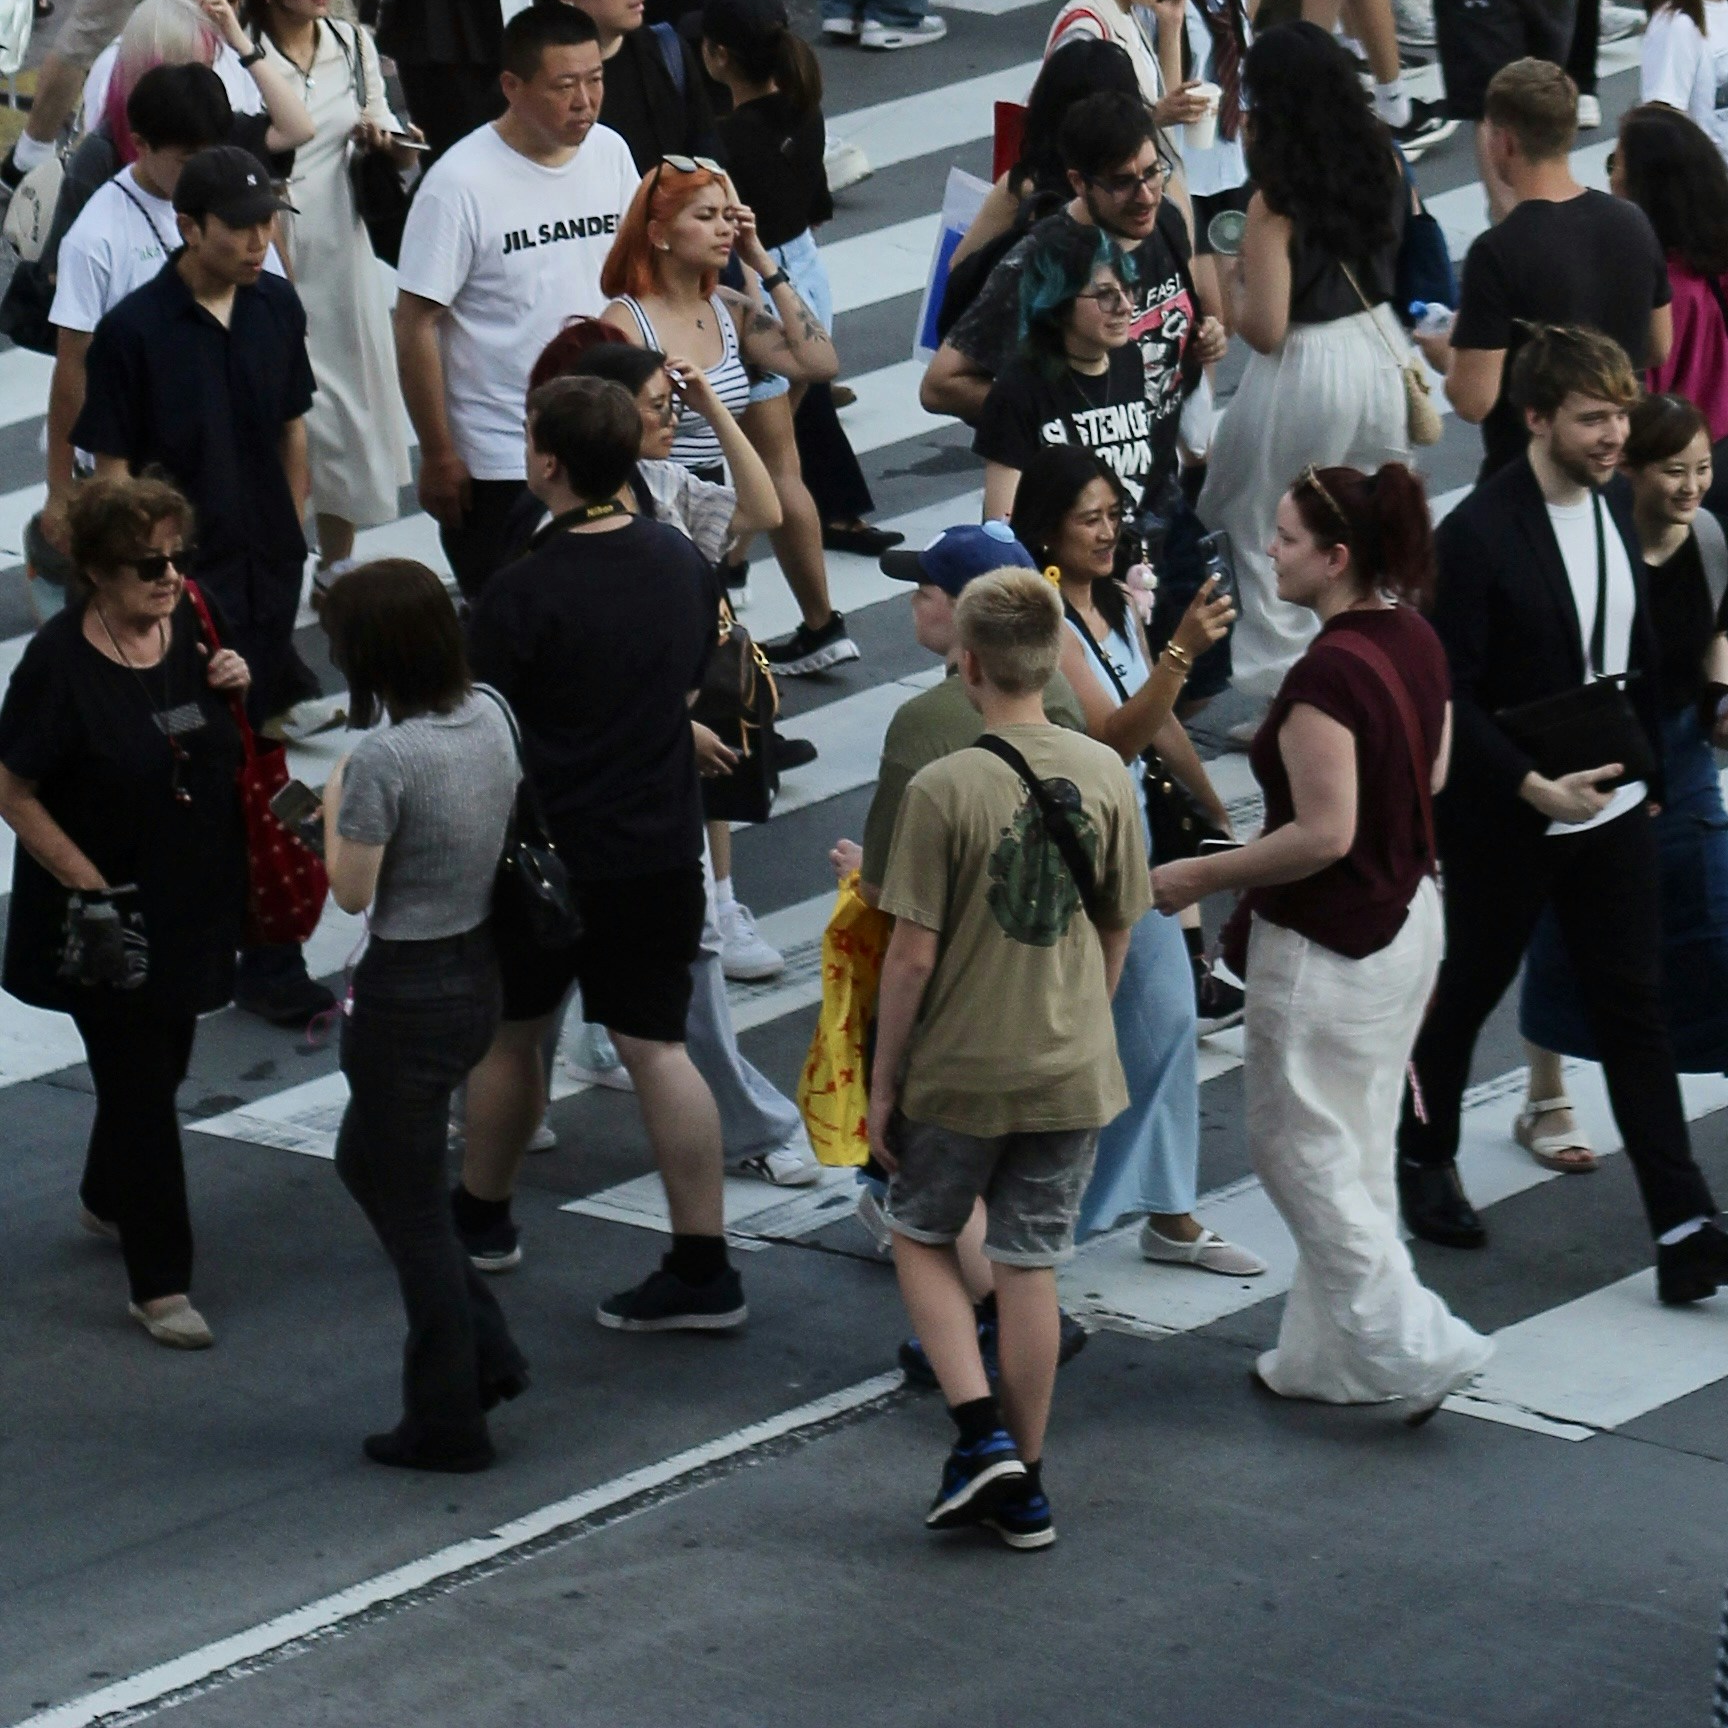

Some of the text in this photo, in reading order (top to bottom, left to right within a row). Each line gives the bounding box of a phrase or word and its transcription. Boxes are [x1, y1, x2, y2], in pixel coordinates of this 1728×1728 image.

[502, 213, 620, 254] JIL SANDE
[1042, 401, 1131, 446] SSTEM
